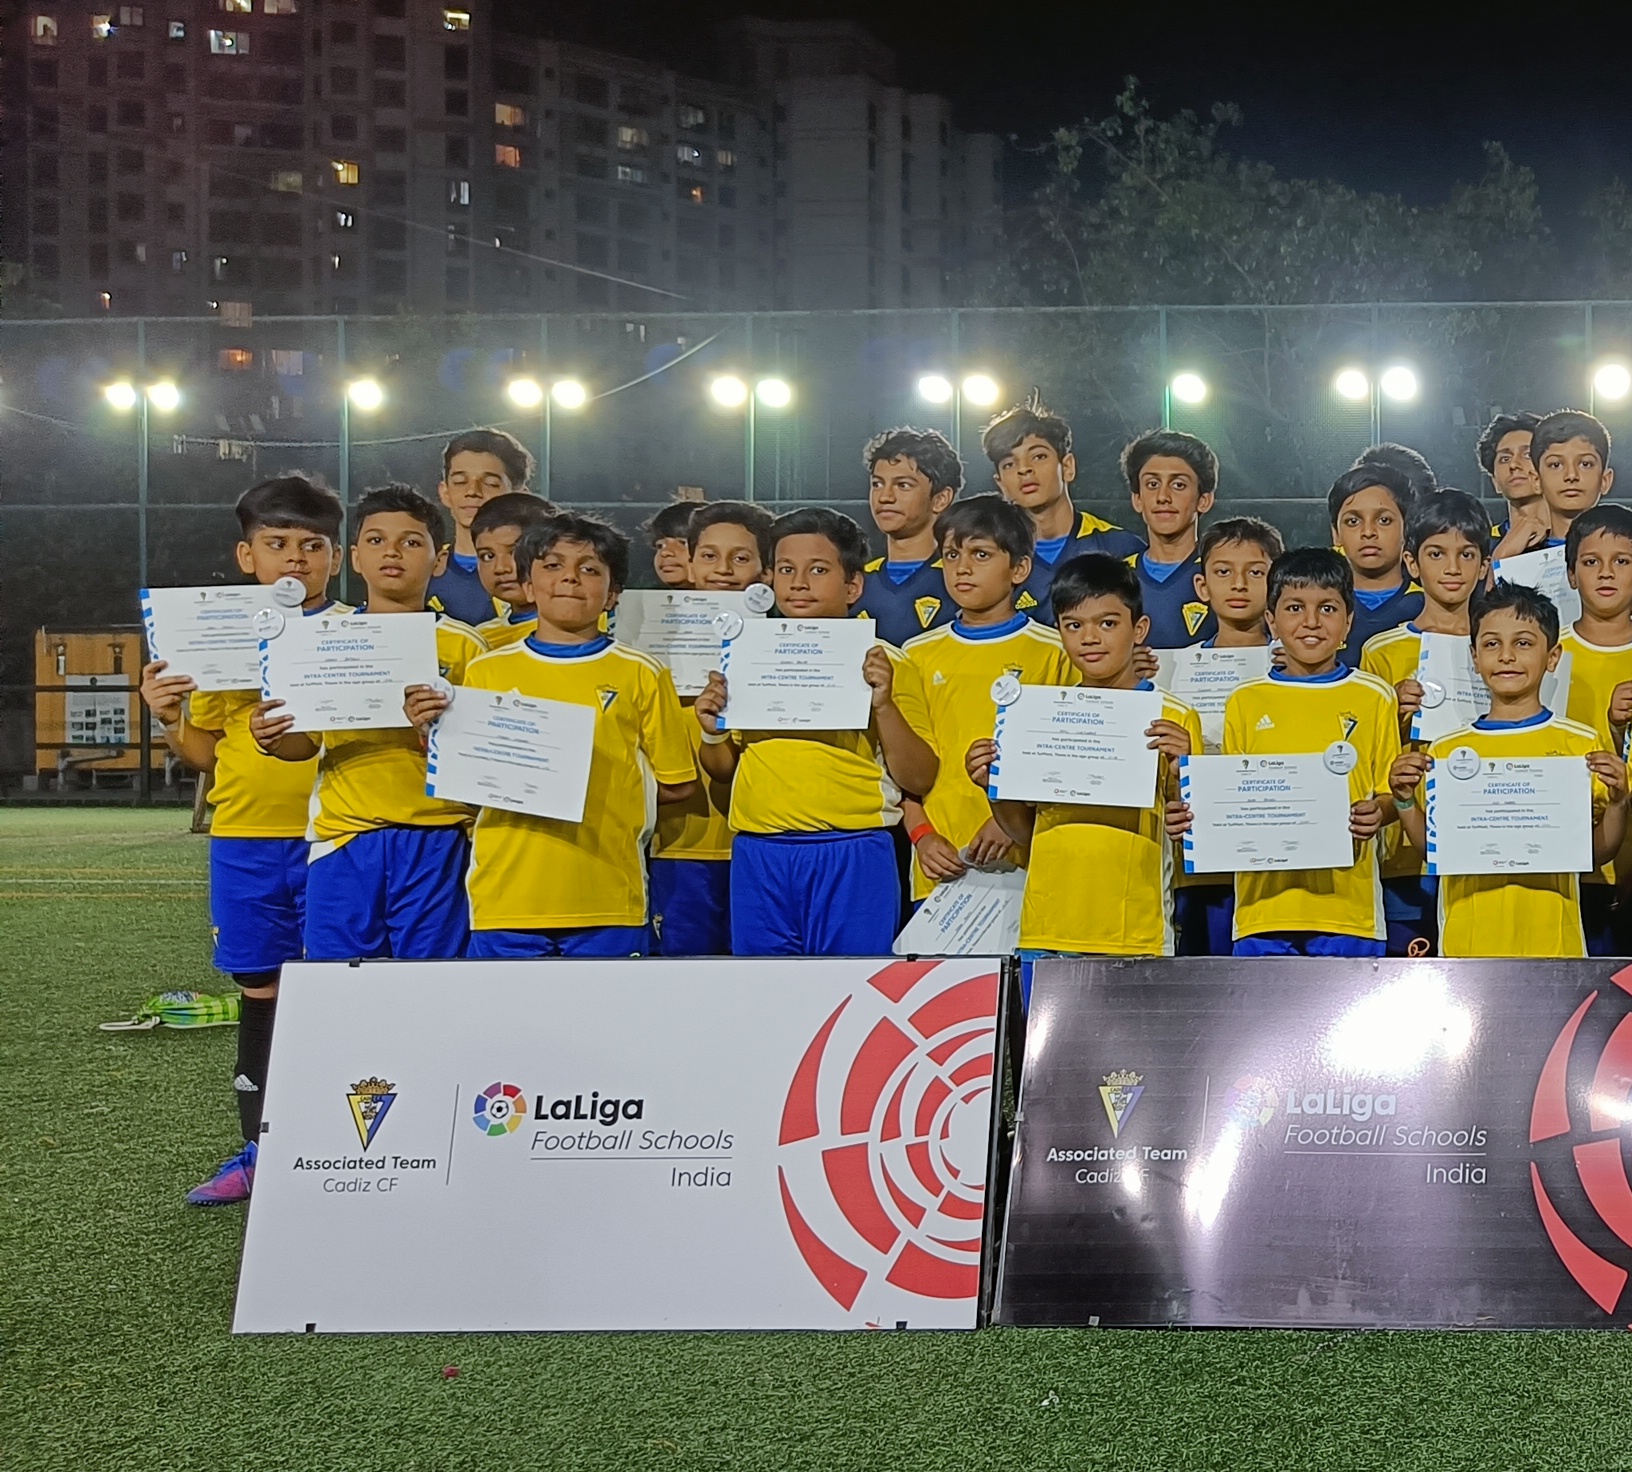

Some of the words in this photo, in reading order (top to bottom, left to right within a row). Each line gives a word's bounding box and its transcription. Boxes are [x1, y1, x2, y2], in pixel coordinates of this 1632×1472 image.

[316, 644, 375, 652] PARTICIPATION
[1052, 717, 1104, 725] PARTICIPATION
[534, 1091, 644, 1126] LaLiga
[1286, 1087, 1396, 1122] LaLiga
[531, 1130, 633, 1150] Football
[639, 1130, 734, 1150] Schools
[1284, 1124, 1386, 1146] Football
[1393, 1125, 1487, 1147] Schools
[293, 1156, 386, 1170] Associated
[392, 1156, 436, 1170] Team
[1046, 1146, 1136, 1161] Associated
[1142, 1147, 1187, 1160] Team
[671, 1167, 731, 1187] India
[1426, 1163, 1486, 1184] India
[323, 1178, 371, 1193] Cadiz
[377, 1177, 399, 1192] CF
